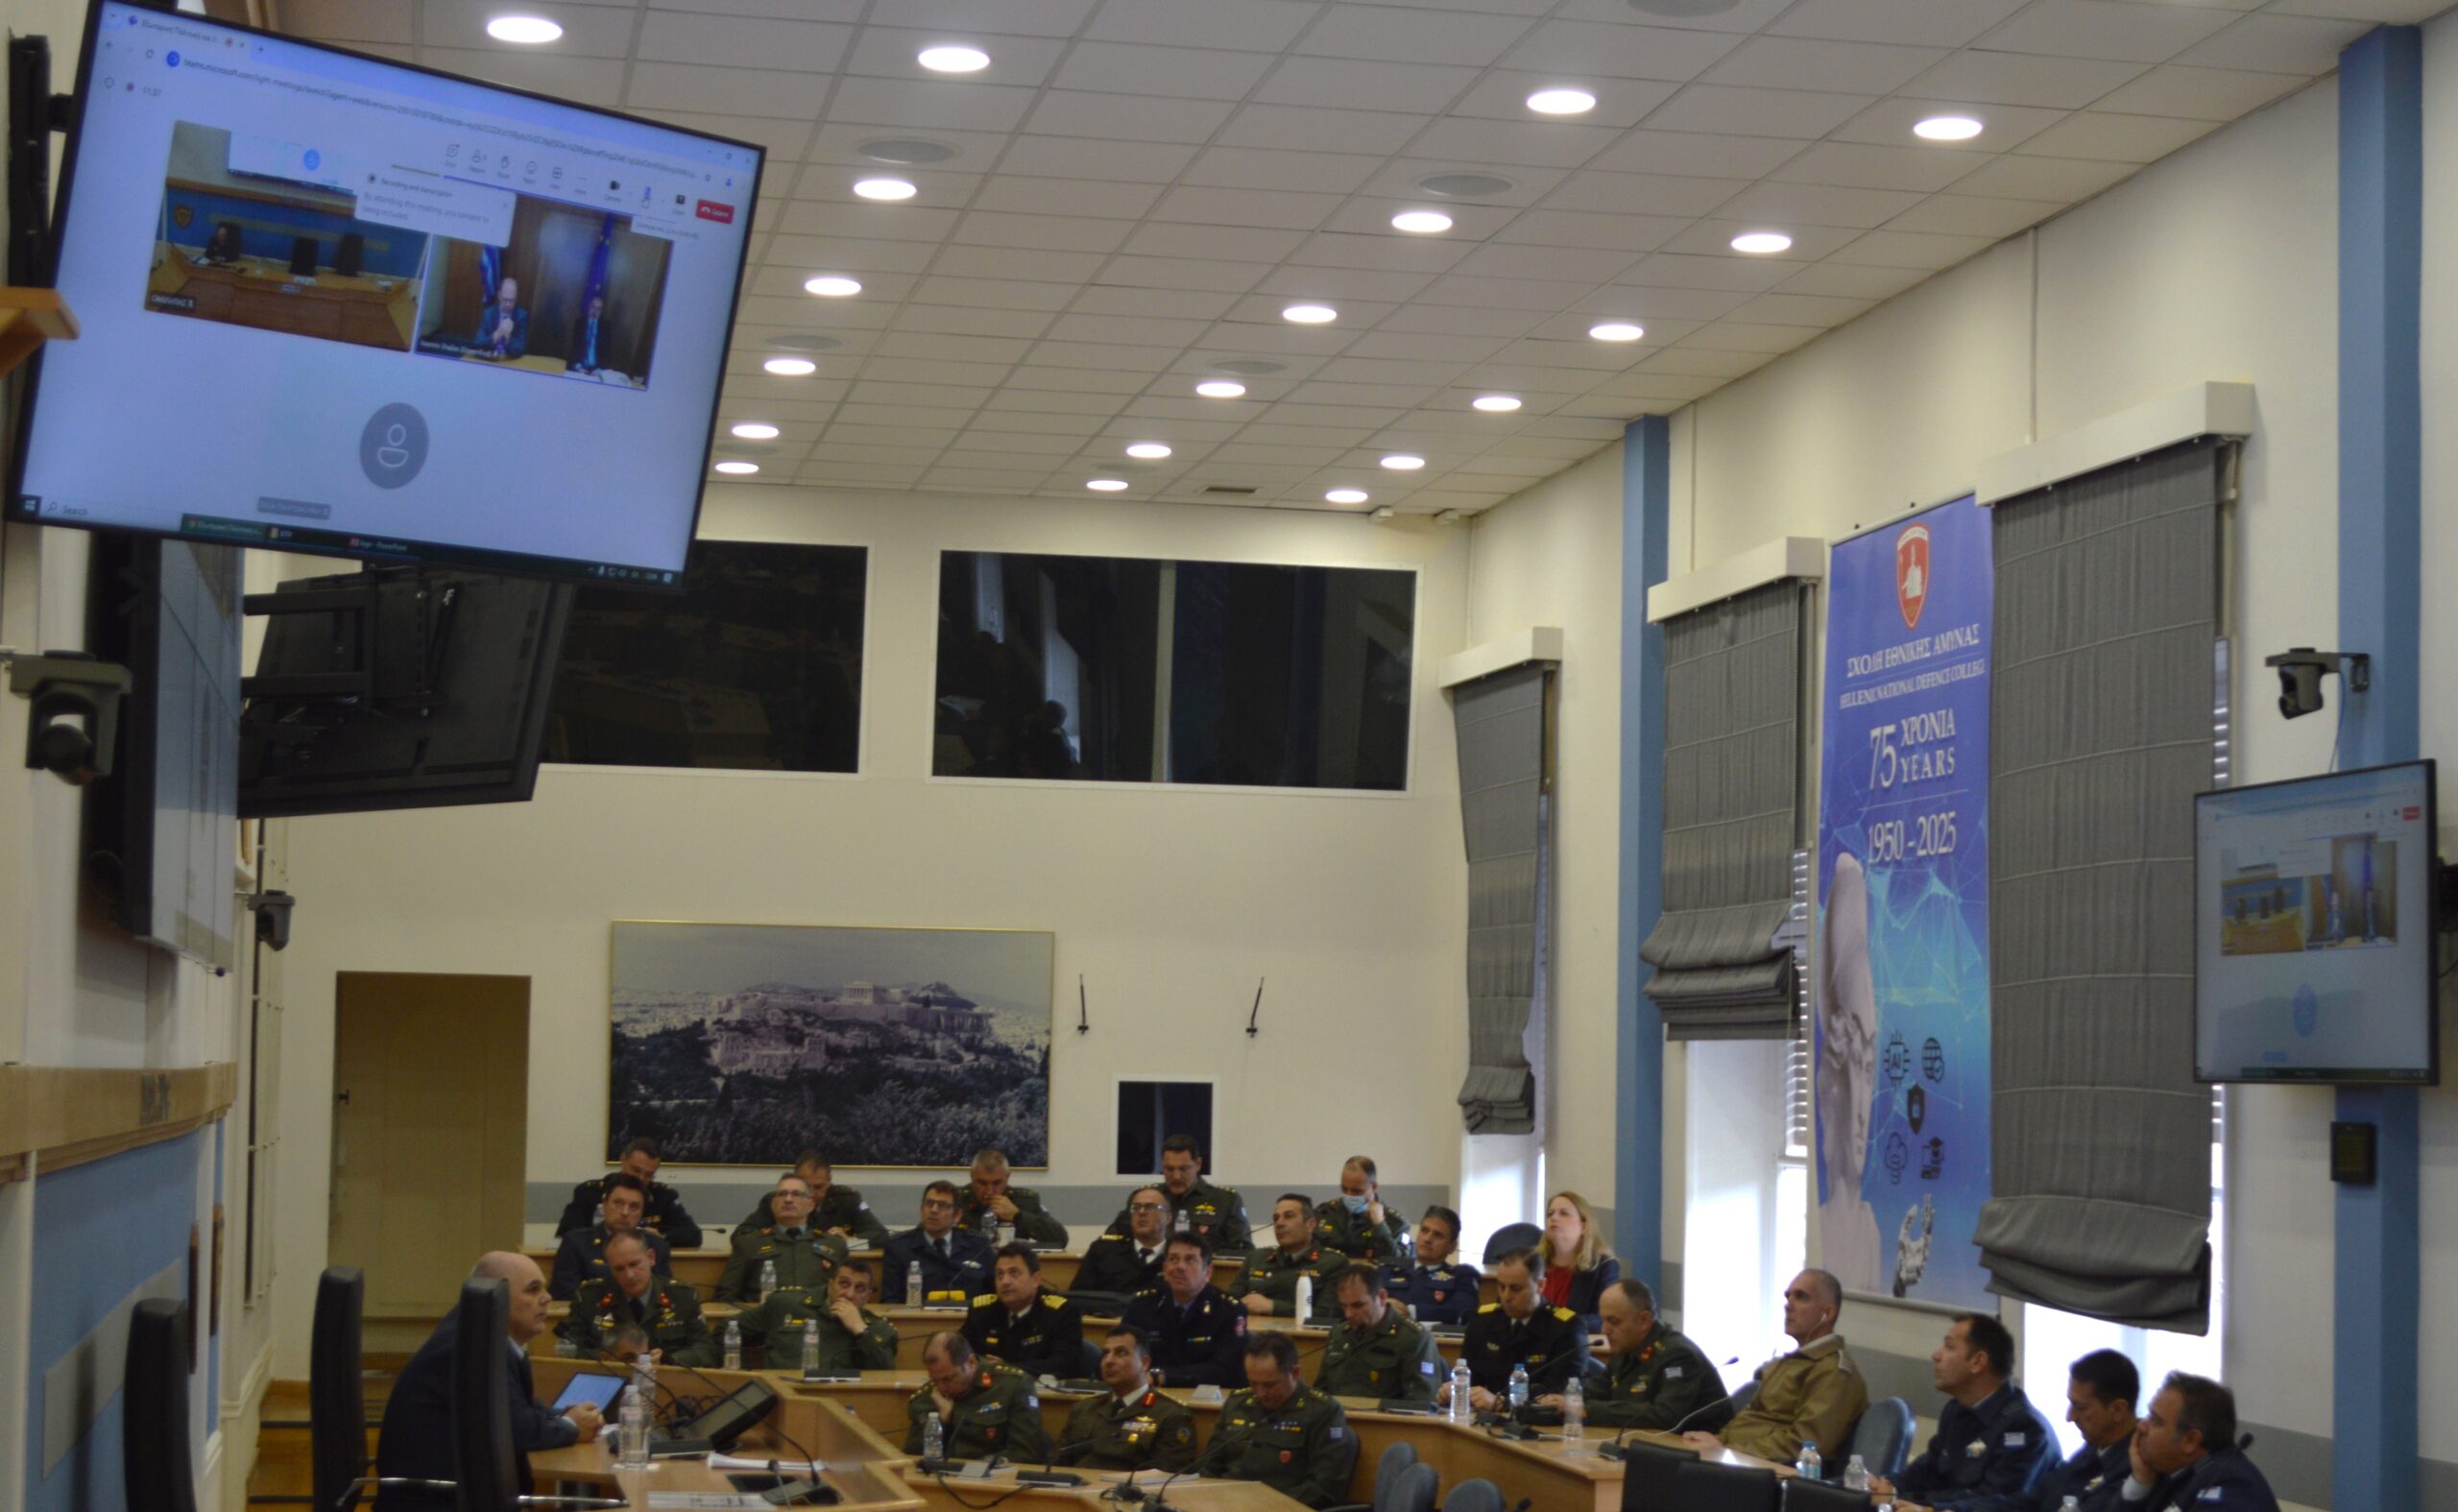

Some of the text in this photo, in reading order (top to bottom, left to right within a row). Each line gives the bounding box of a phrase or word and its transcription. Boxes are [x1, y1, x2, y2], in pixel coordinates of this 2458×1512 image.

[711, 208, 729, 218] Leave
[62, 505, 88, 516] Search
[1885, 637, 1932, 668] ΕΘΝΙΚΗΣ
[1933, 623, 1980, 656] ΑΜΥΝΑΣ
[1877, 676, 1916, 700] NATIONAL
[1916, 667, 1951, 690] DEFENCE
[1901, 708, 1956, 747] ΧΡΟΝΙΑ
[1870, 724, 1897, 790] 75
[1900, 747, 1955, 783] YEARS
